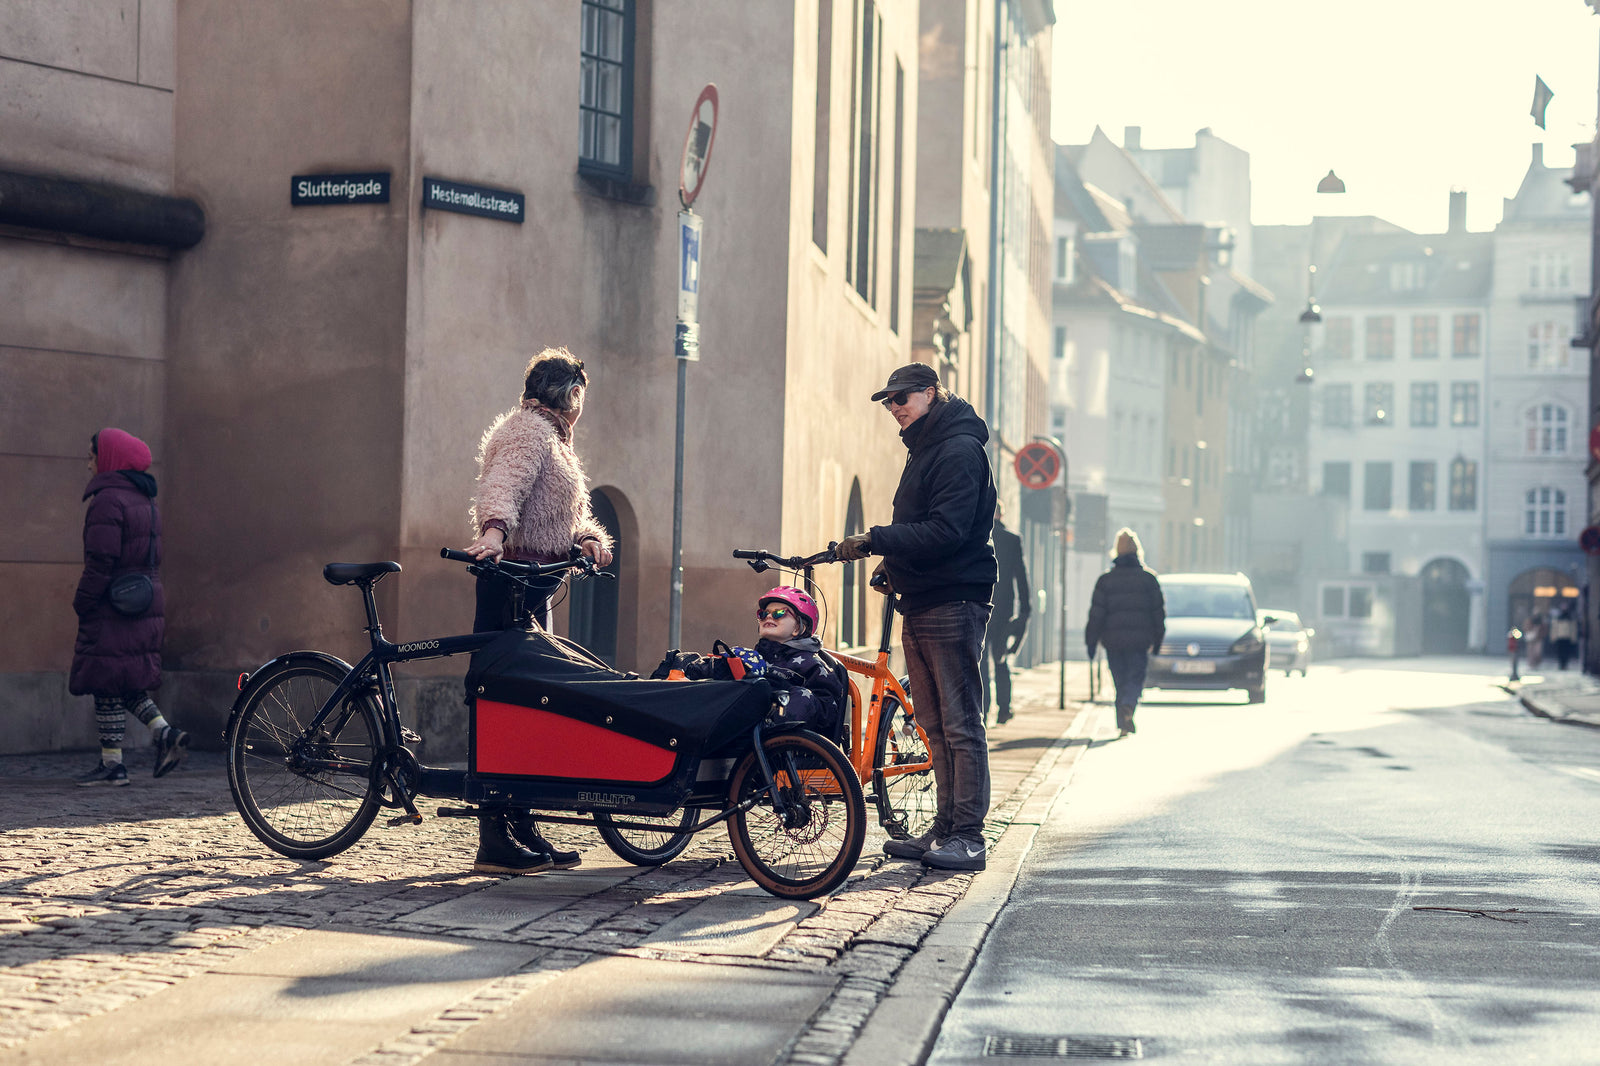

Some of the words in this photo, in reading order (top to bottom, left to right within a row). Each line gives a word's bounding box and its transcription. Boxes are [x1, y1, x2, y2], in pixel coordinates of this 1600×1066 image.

[298, 179, 382, 199] Slutterigade
[431, 184, 519, 215] Hestemøllestræde
[398, 640, 440, 653] MOONDOG
